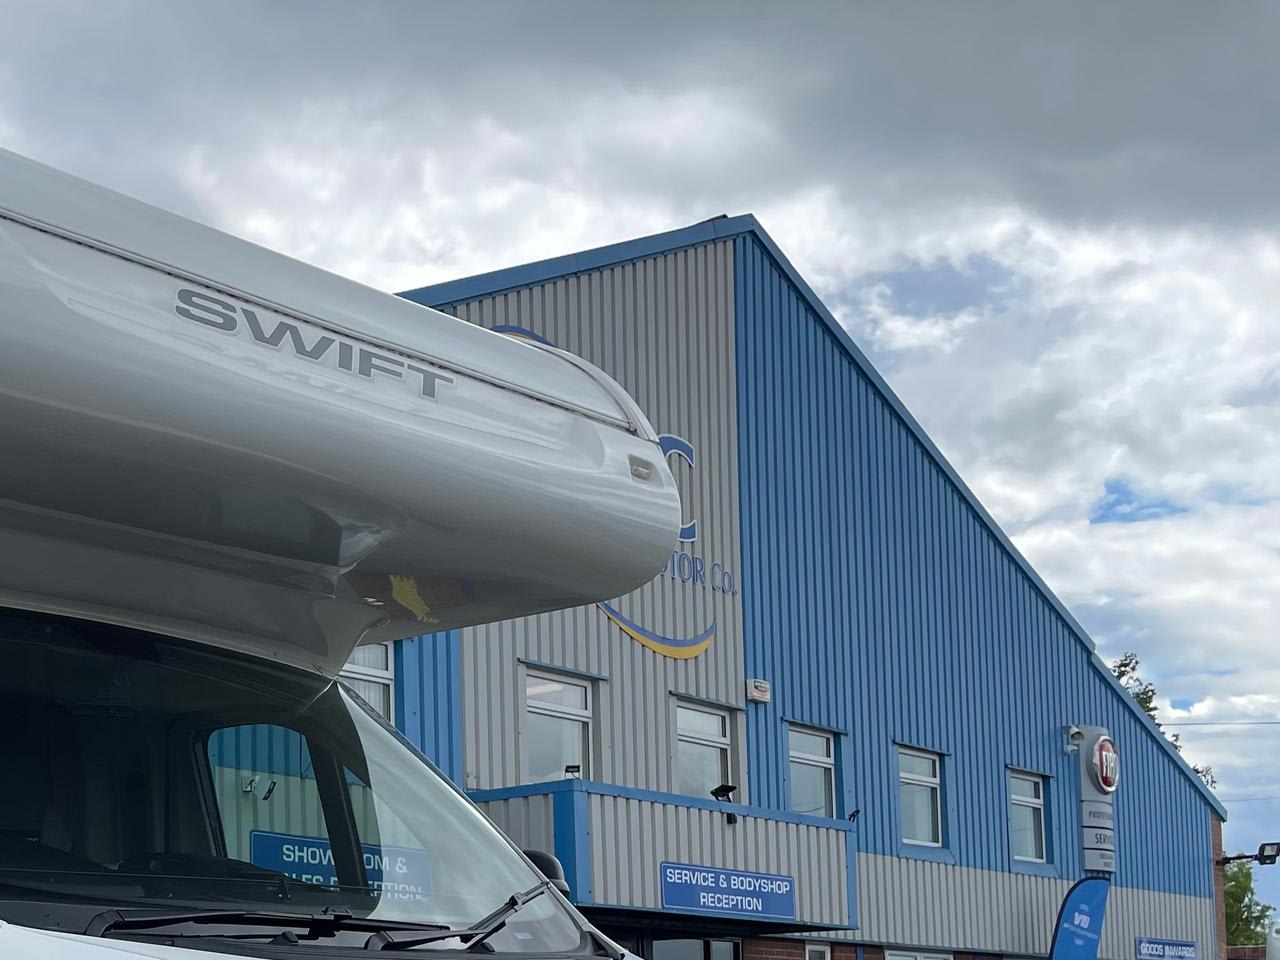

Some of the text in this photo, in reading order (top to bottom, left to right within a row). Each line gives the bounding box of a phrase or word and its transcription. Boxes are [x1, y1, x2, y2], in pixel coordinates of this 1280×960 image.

[174, 287, 455, 399] SWIFT
[660, 550, 705, 588] TOR
[282, 843, 408, 873] SHOWOM &
[666, 868, 791, 895] SERVICE & BODYSHOP
[700, 892, 763, 911] RECEPTION
[1140, 943, 1196, 958] GOODS INWARDS
